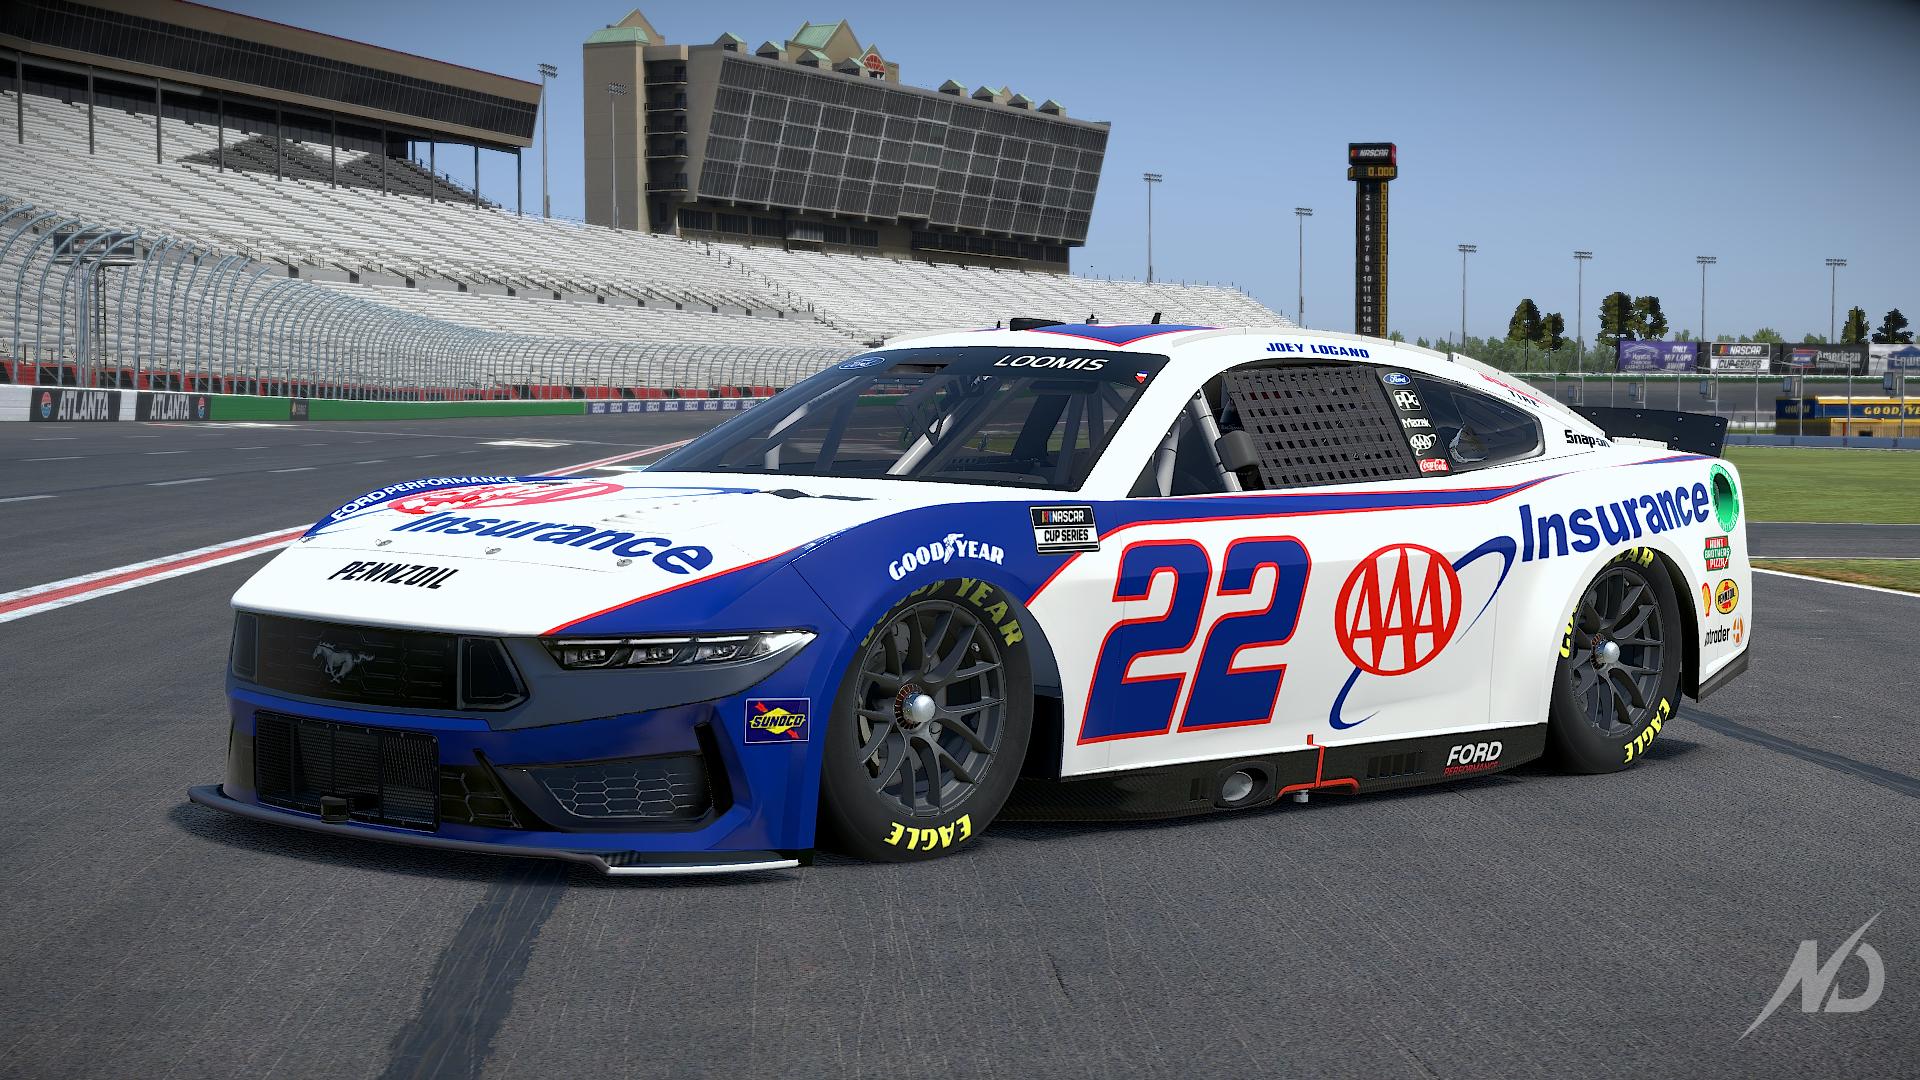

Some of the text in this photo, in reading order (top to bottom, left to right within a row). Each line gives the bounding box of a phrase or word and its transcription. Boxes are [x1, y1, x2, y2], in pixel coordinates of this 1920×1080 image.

[1360, 149, 1389, 157] NASCAR
[1266, 342, 1370, 359] JOEY LOGANO
[1730, 345, 1762, 355] NASCAR
[994, 355, 1109, 372] LOOMIS
[57, 390, 109, 421] ATLANTA
[149, 394, 190, 421] ATLANTA
[1395, 391, 1420, 409] PPG
[1401, 417, 1432, 429] Mazak
[1564, 429, 1611, 448] Snap-on
[330, 490, 387, 520] FORD
[383, 476, 519, 496] PERFORMANCE
[1052, 510, 1085, 523] NASCAR
[1520, 482, 1710, 563] Insurance
[392, 511, 714, 575] Insurance
[1044, 528, 1089, 543] CUP SERIES
[1704, 547, 1730, 559] BROTHERS
[327, 560, 460, 590] PENNZOIL
[1337, 543, 1460, 675] AAA
[1077, 535, 1312, 746] 22
[751, 714, 805, 729] SUNOCO
[1623, 697, 1671, 764] EAGLE
[1446, 741, 1503, 767] FORD
[883, 813, 972, 851] EAGLE
